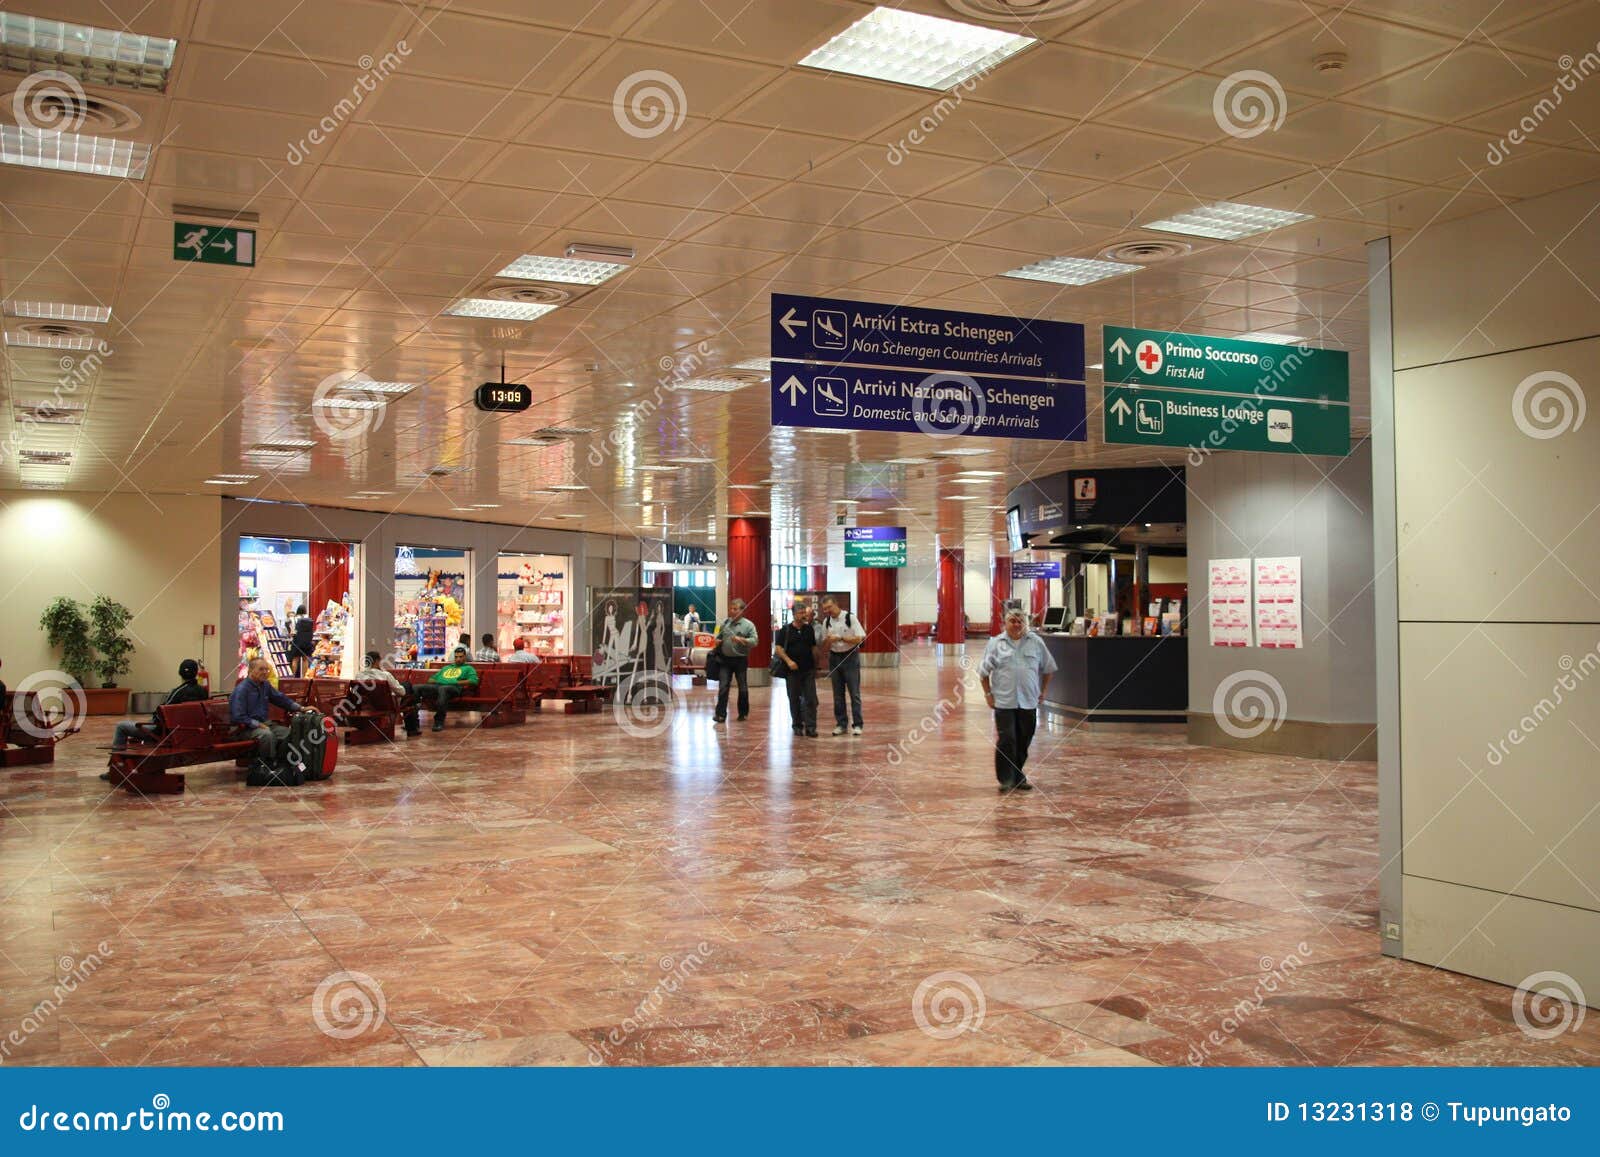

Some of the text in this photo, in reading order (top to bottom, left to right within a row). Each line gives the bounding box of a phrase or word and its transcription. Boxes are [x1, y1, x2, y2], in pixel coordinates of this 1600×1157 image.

[853, 313, 1014, 344] Arrivi Extra Schengen
[852, 339, 1042, 367] Non Schengen Countries Arrivals
[1165, 342, 1259, 365] Primo Soccorso
[1165, 365, 1205, 380] First Aid
[491, 390, 521, 402] 13:09
[853, 379, 897, 398] Arrivi
[901, 382, 972, 403] Nazionali
[986, 388, 1055, 410] Schengen
[853, 405, 1040, 429] Domestic and Schengen Arrivals
[1166, 401, 1265, 425] Business Lounge
